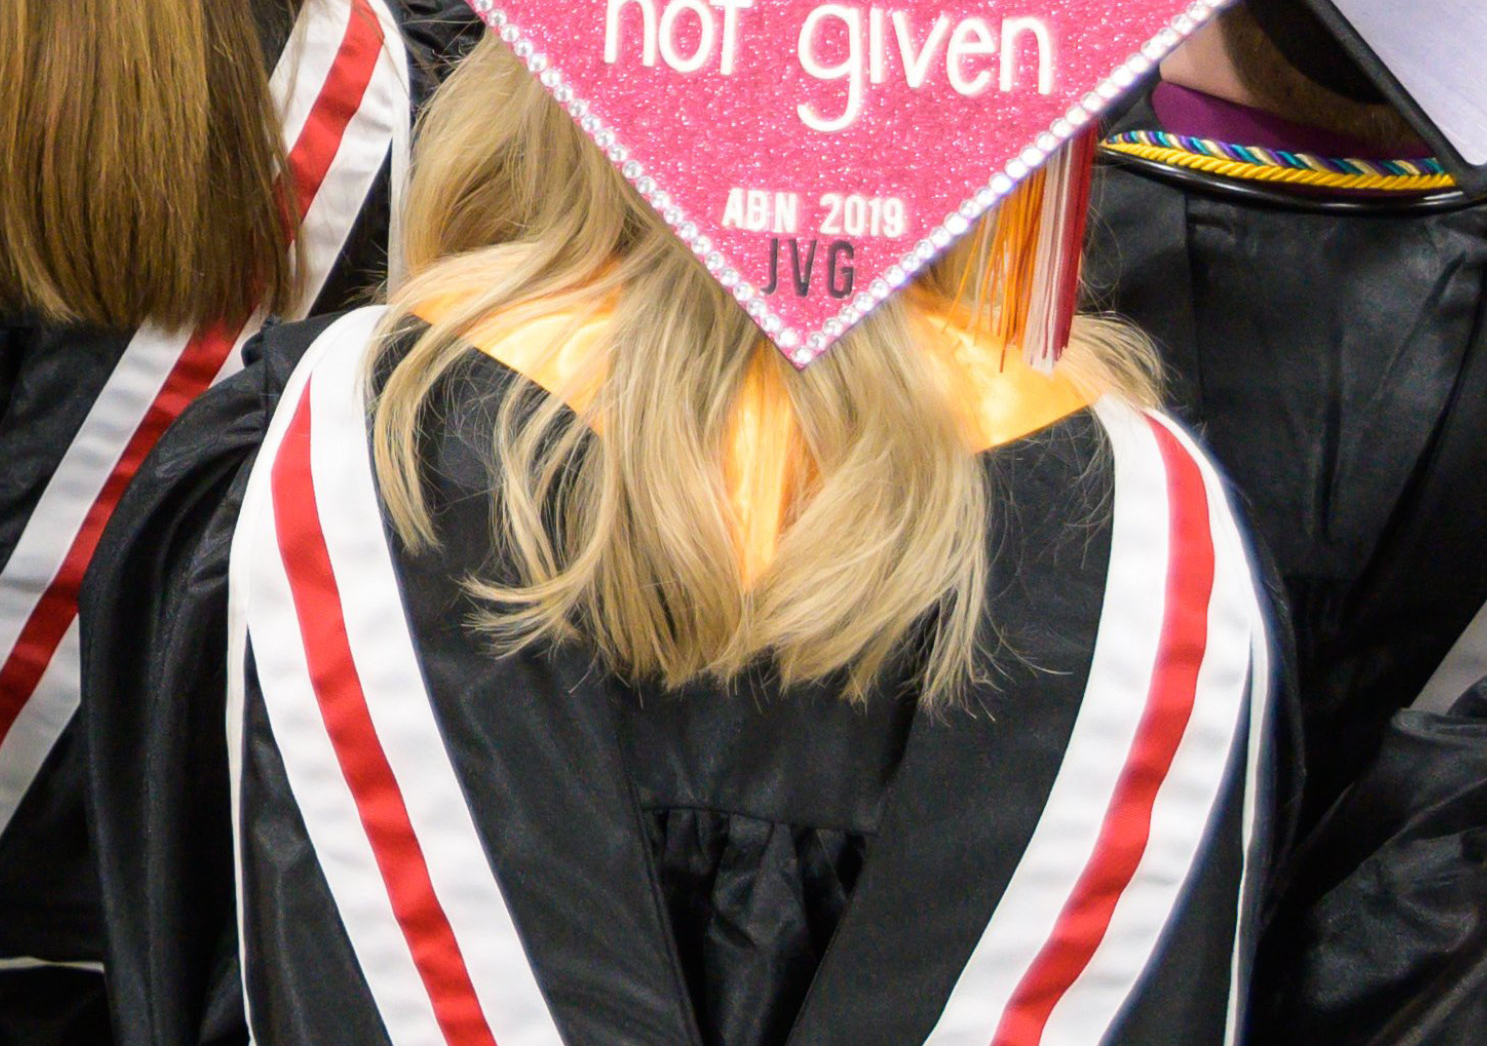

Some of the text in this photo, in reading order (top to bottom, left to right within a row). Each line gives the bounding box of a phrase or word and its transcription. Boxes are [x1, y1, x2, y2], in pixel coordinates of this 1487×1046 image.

[721, 187, 904, 238] ABN 2019
[762, 237, 855, 299] JVG
